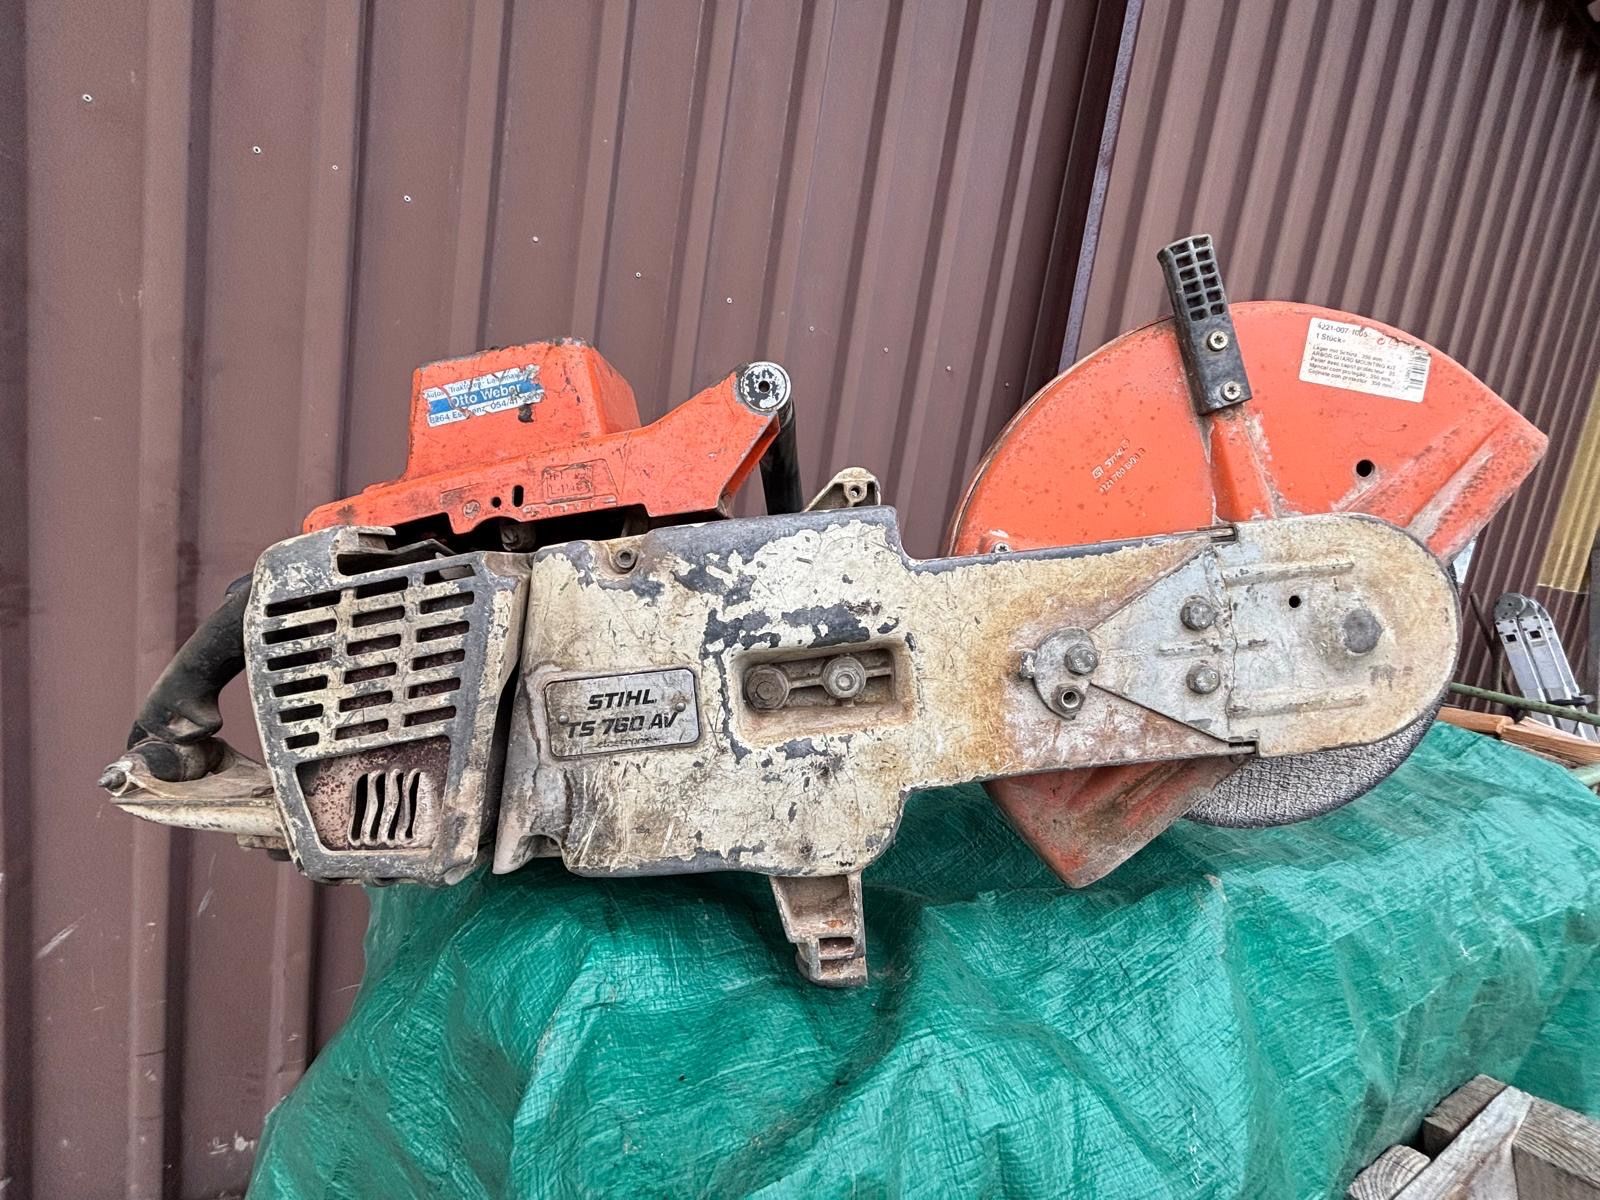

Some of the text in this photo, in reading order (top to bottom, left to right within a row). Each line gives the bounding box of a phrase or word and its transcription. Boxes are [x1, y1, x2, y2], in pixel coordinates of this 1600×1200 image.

[587, 688, 656, 711] STIHL
[568, 711, 680, 739] TS 760 AV
